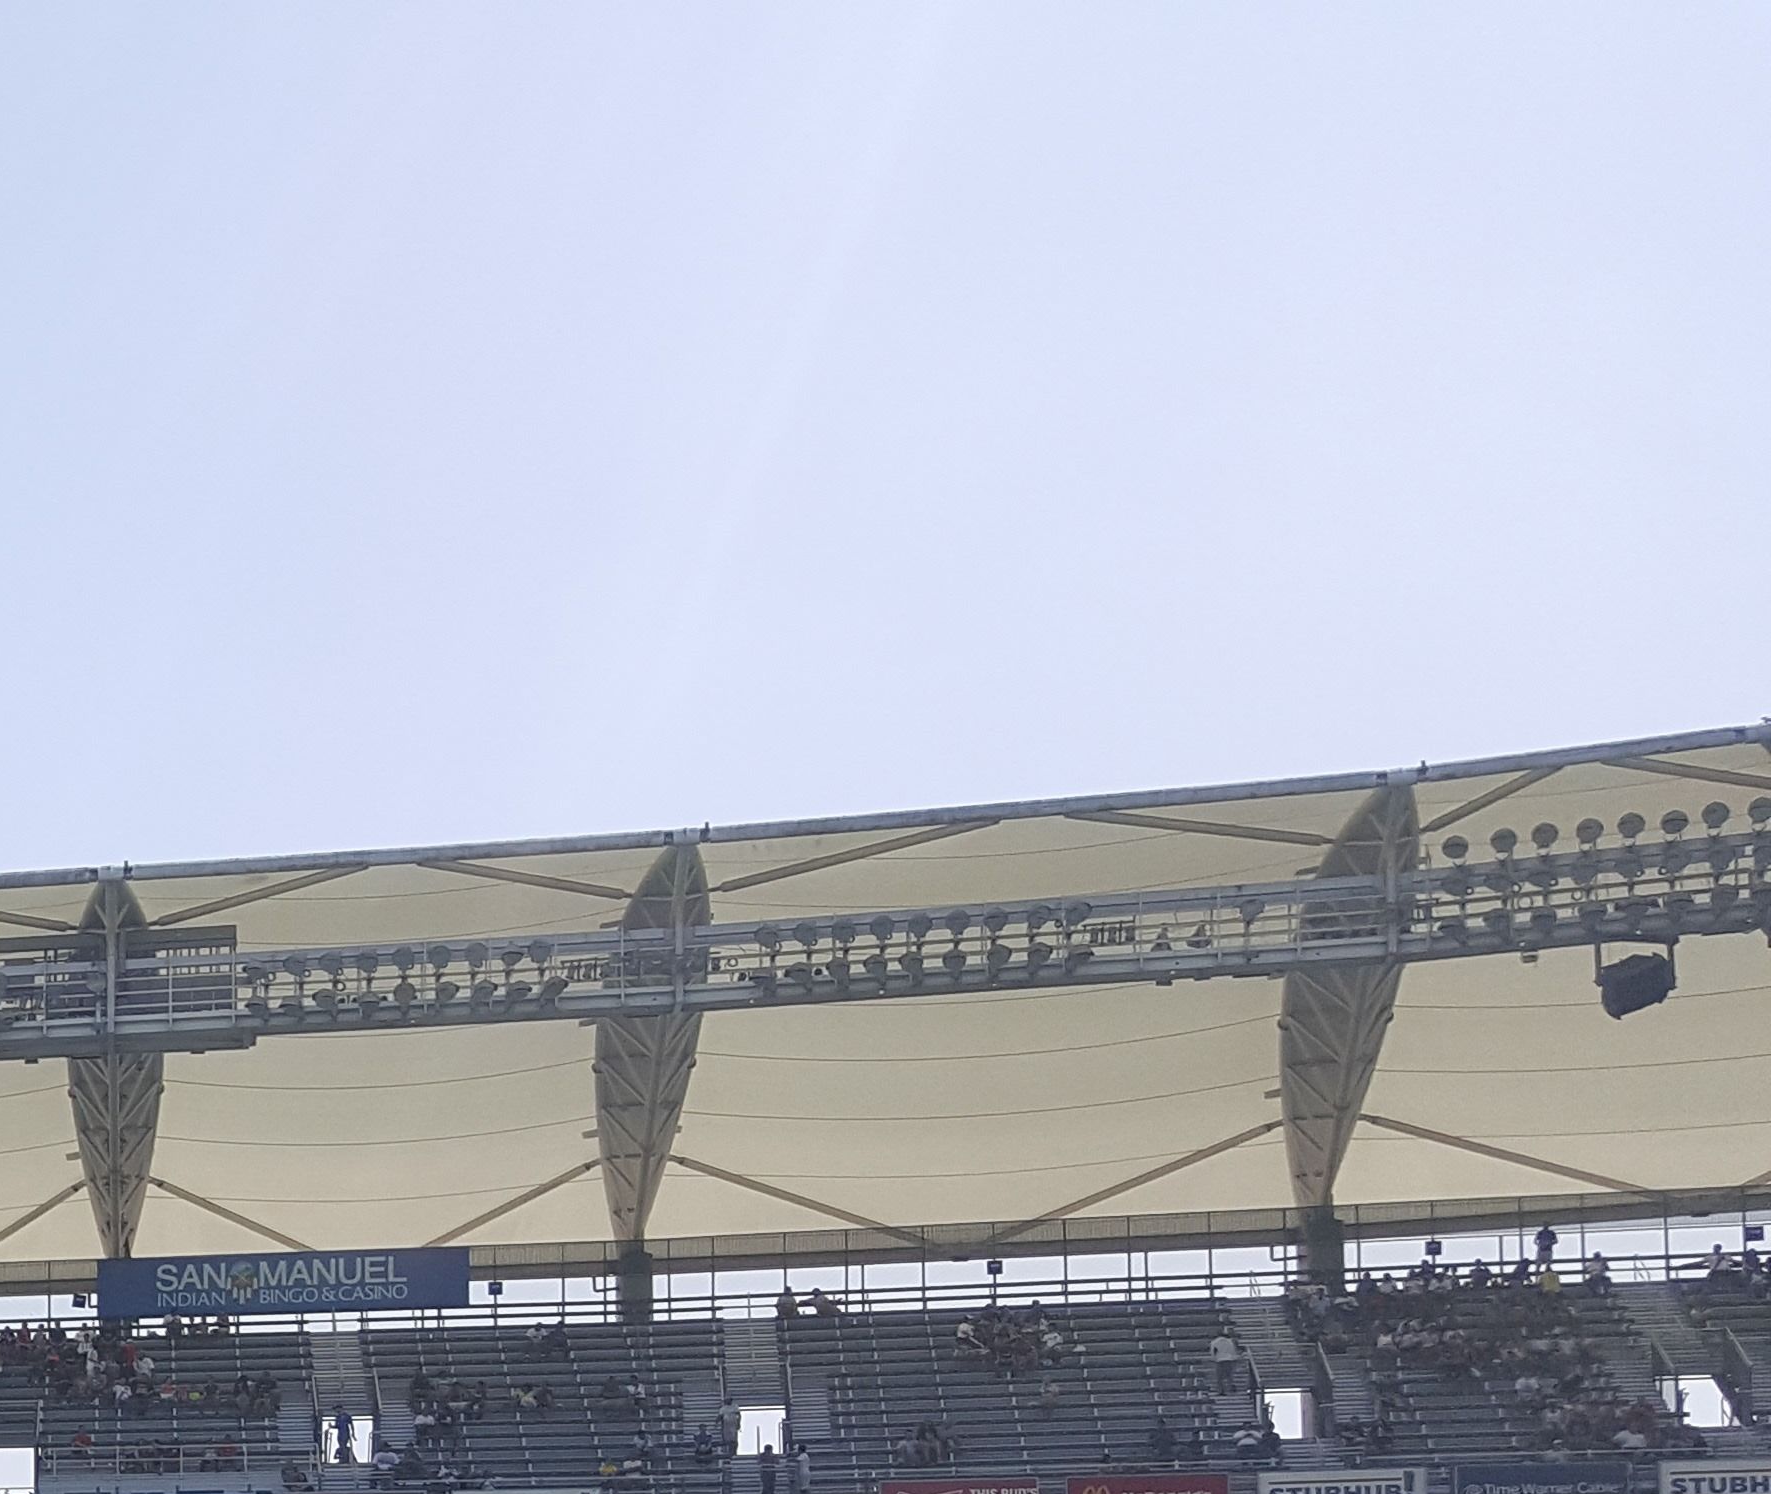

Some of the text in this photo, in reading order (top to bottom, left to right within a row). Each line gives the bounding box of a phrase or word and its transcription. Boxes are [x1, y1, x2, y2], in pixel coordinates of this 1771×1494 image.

[156, 1256, 408, 1292] SAN MANUEL
[157, 1284, 408, 1308] INDIAN BINGO & CASINO
